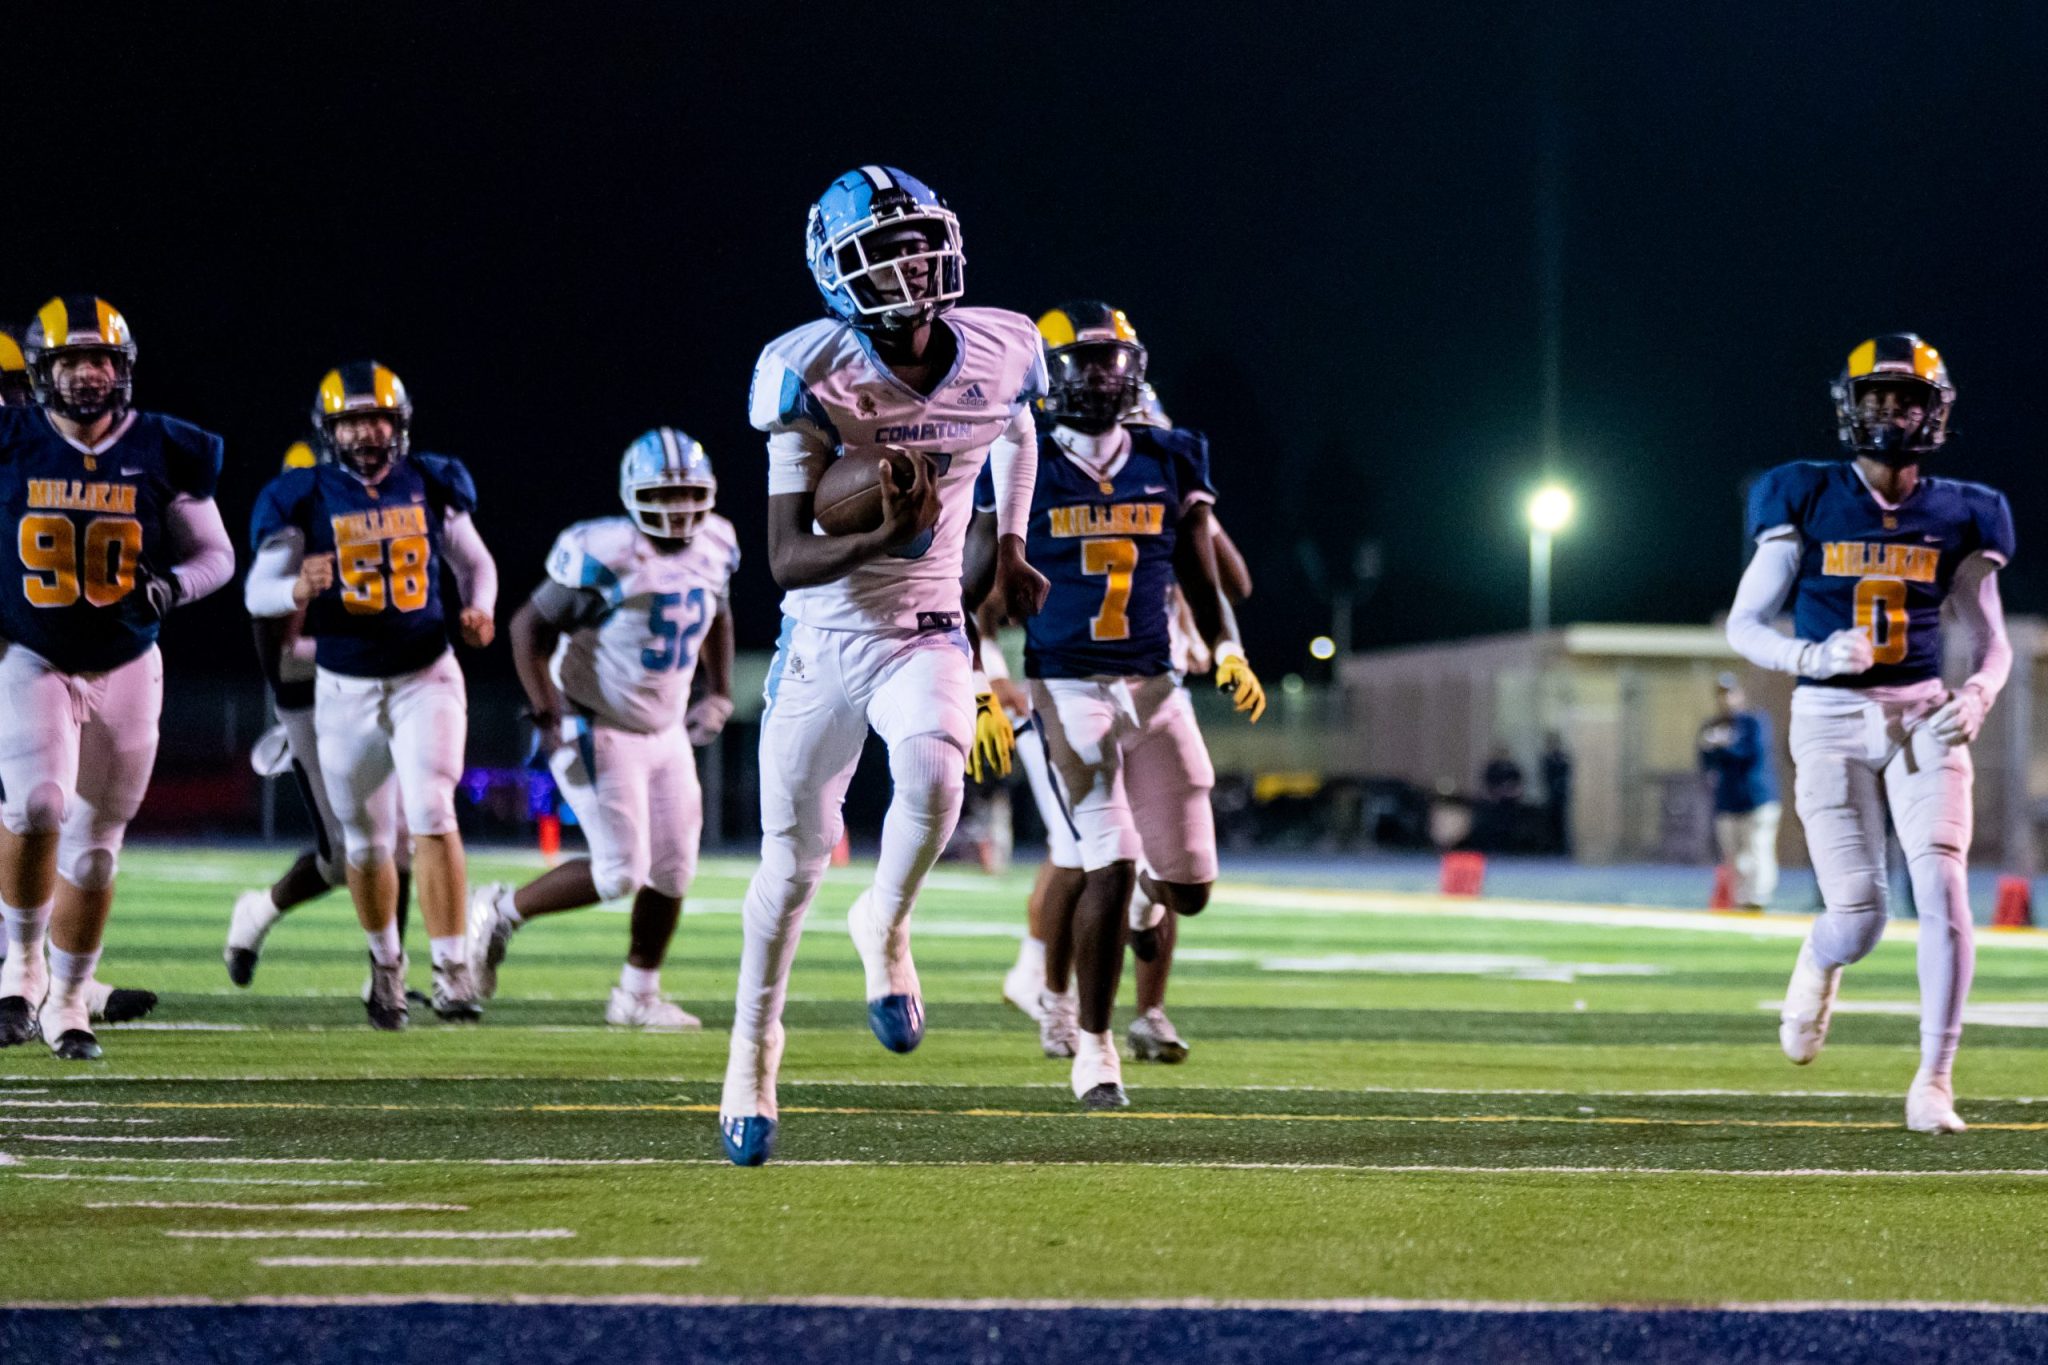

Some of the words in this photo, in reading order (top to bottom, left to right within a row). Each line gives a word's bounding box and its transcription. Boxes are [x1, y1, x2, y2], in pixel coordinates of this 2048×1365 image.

[875, 422, 973, 443] COMPTON
[28, 479, 136, 512] MILLIKAN
[332, 506, 428, 545] MILLIKAN
[1049, 504, 1165, 537] MILLIKAN
[19, 514, 142, 607] 90
[337, 535, 429, 614] 58
[1082, 538, 1137, 641] 7
[1823, 542, 1940, 583] MILLIKAN
[641, 588, 704, 670] 52
[1854, 577, 1909, 665] 0
